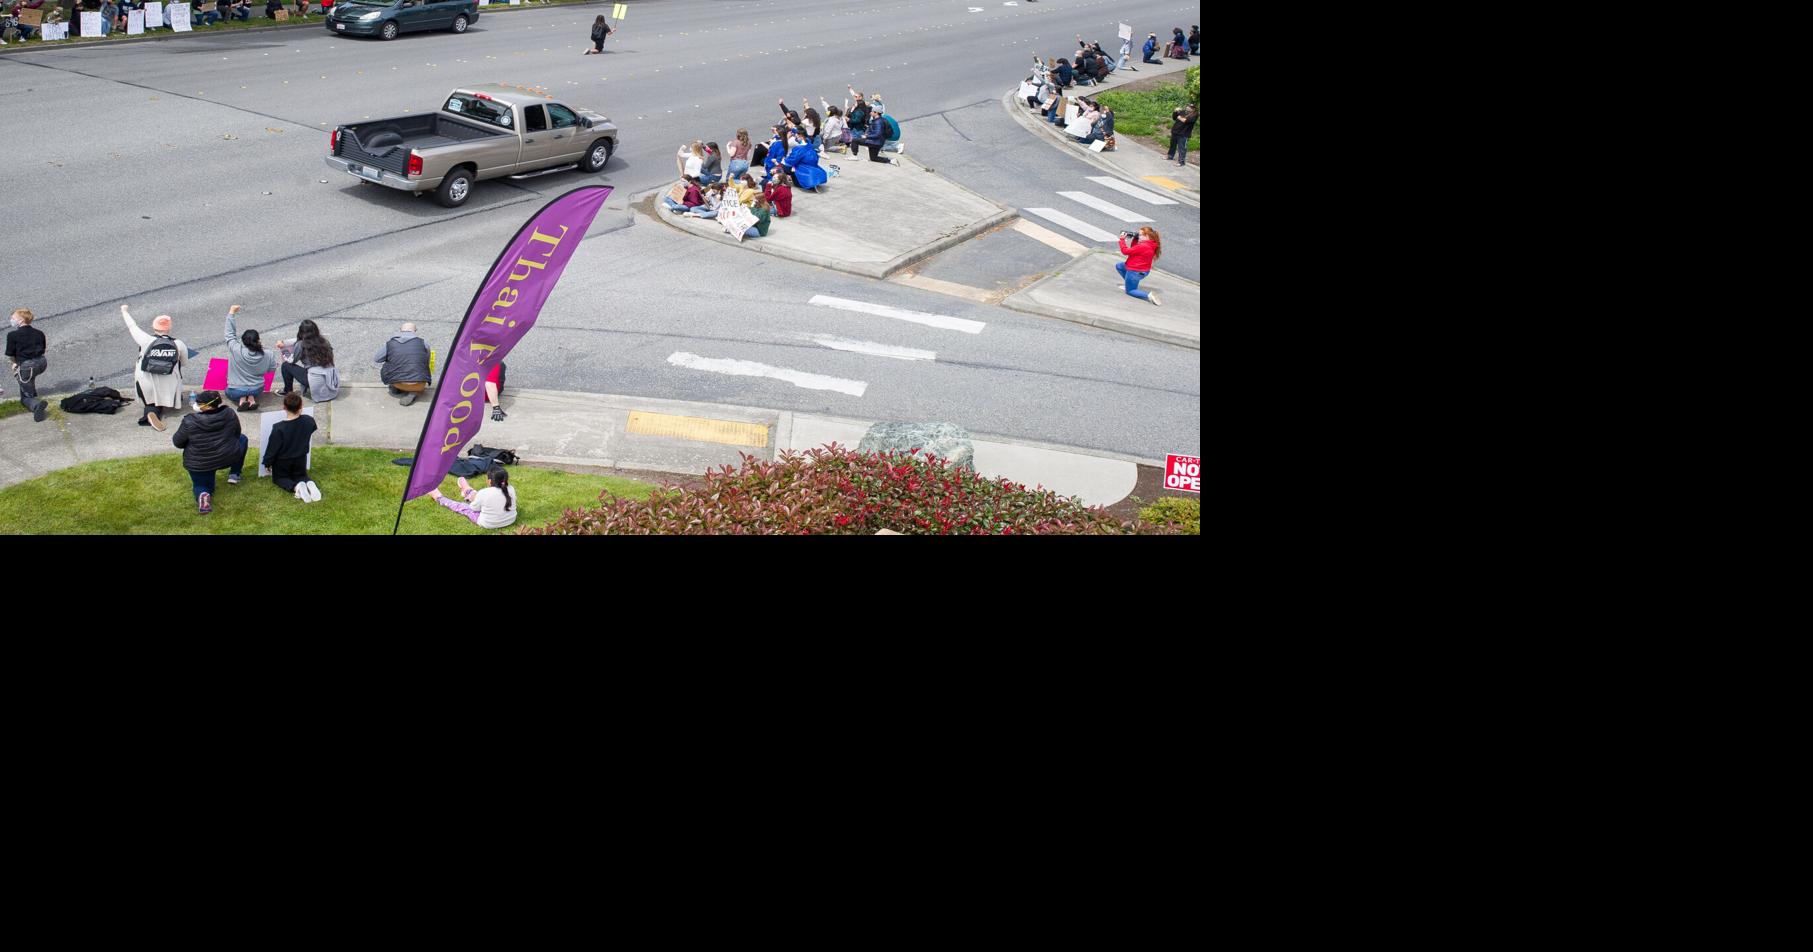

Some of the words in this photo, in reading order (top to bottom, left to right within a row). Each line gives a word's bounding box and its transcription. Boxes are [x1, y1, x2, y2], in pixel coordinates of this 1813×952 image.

[482, 224, 568, 328] Thai
[440, 341, 501, 456] Food
[1173, 462, 1200, 476] NO
